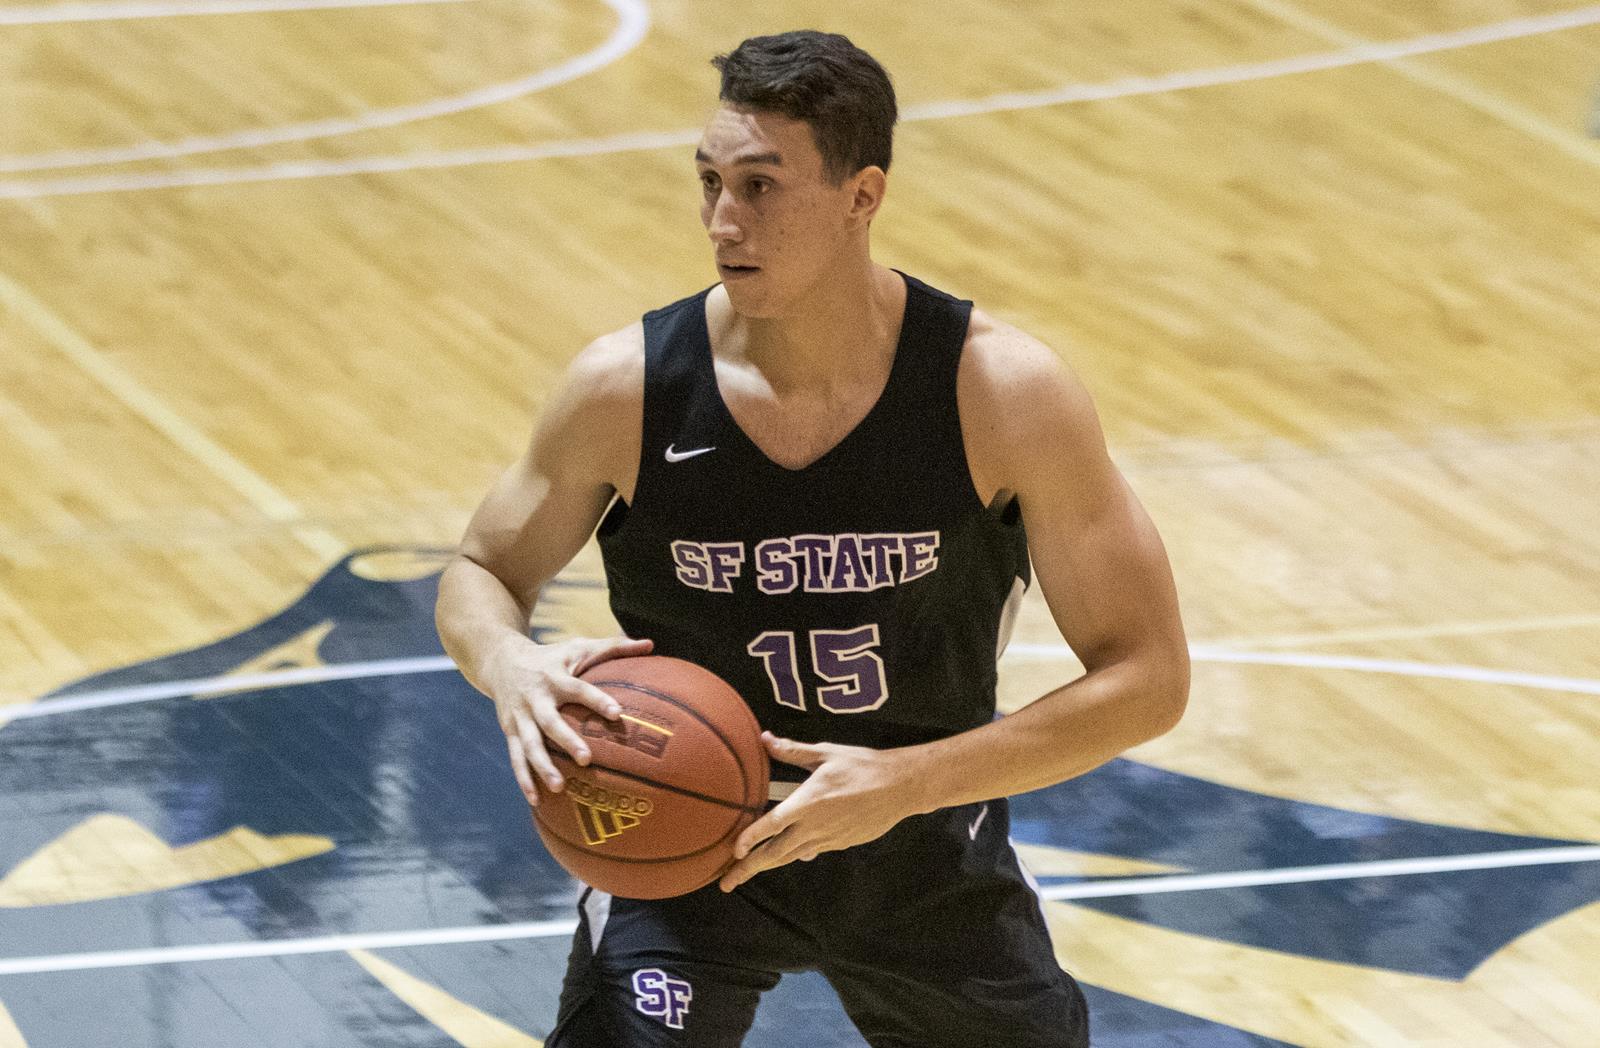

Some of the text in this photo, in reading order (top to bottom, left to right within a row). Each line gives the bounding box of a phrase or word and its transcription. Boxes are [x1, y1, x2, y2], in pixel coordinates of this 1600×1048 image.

[671, 531, 940, 594] SF STATE
[747, 624, 889, 714] 15
[632, 968, 693, 1029] SF
